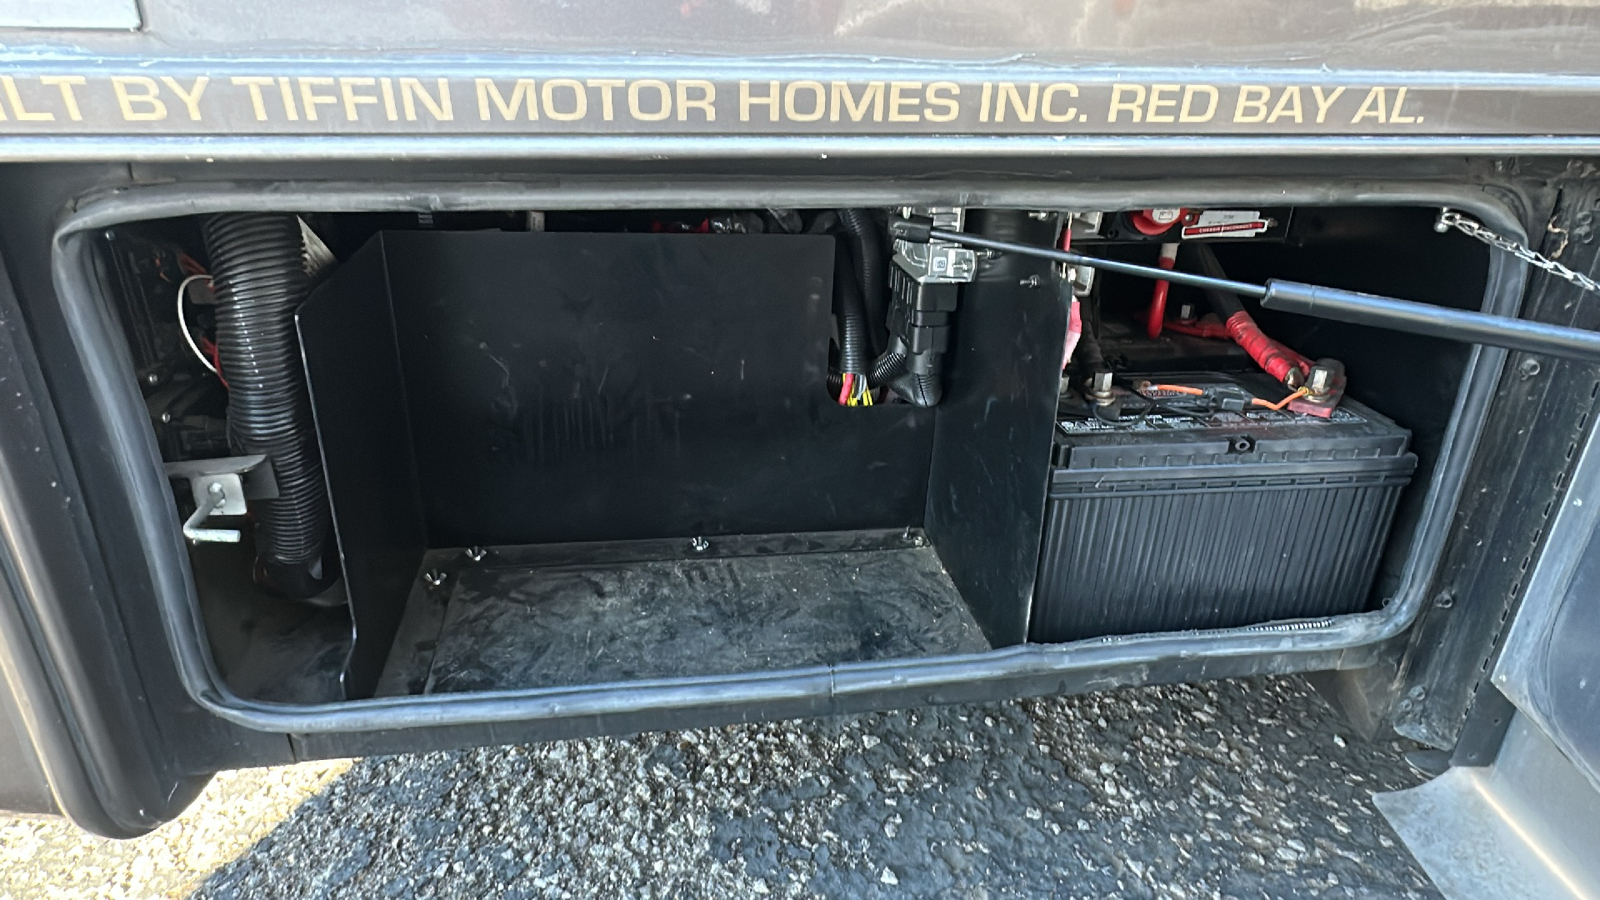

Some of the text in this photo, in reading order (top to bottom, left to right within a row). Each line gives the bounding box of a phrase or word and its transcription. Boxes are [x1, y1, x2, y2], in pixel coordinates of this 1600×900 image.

[110, 75, 210, 121] BY
[231, 76, 454, 121] TIFFIN
[474, 78, 717, 122] MOTOR
[738, 80, 961, 122] HOMES
[978, 82, 1088, 123] INC.
[1107, 83, 1220, 124] RED
[1232, 85, 1346, 124] BAY
[1350, 86, 1425, 125] AL.
